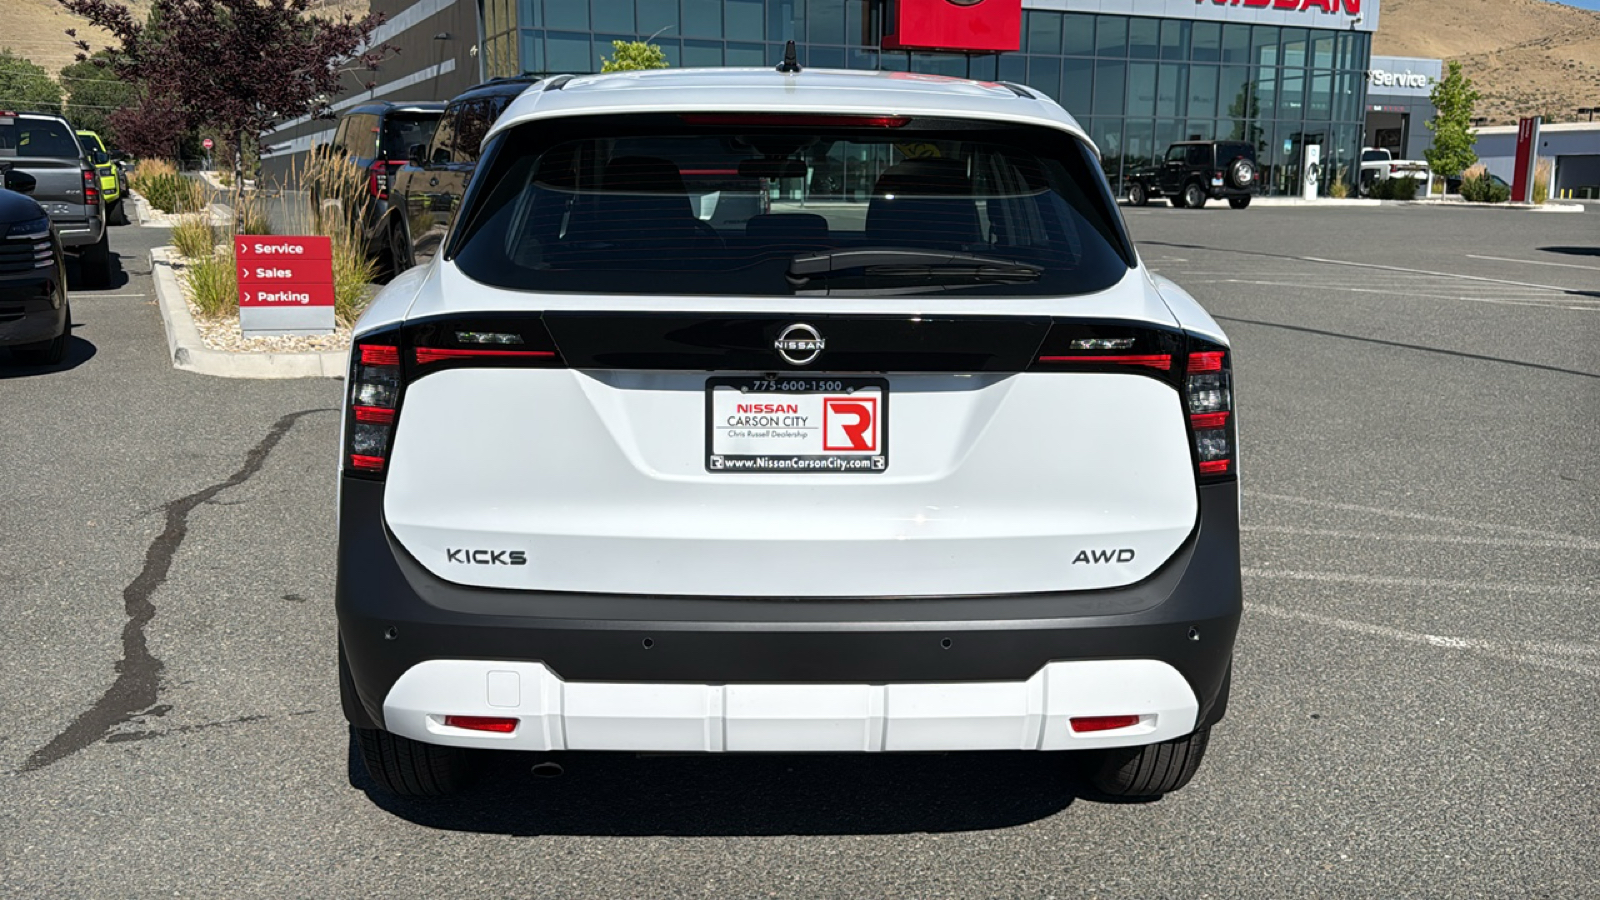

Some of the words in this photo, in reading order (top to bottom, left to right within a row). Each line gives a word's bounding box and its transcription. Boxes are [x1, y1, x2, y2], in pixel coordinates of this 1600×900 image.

[1374, 69, 1427, 87] Service
[254, 243, 304, 254] Service
[256, 267, 292, 278] Sales
[258, 291, 310, 304] Parking
[774, 340, 826, 350] NISSAN
[753, 380, 842, 391] 775-600-1500
[736, 403, 799, 414] NISSAN
[727, 415, 780, 427] CARSON
[783, 415, 809, 427] CITY
[829, 403, 872, 449] R
[728, 429, 746, 439] Chris
[747, 429, 770, 438] Russell
[771, 429, 808, 440] Dealership
[725, 457, 871, 471] www.NissanCarsonCity.com
[446, 548, 528, 566] KICKS
[1071, 548, 1136, 565] AWD
